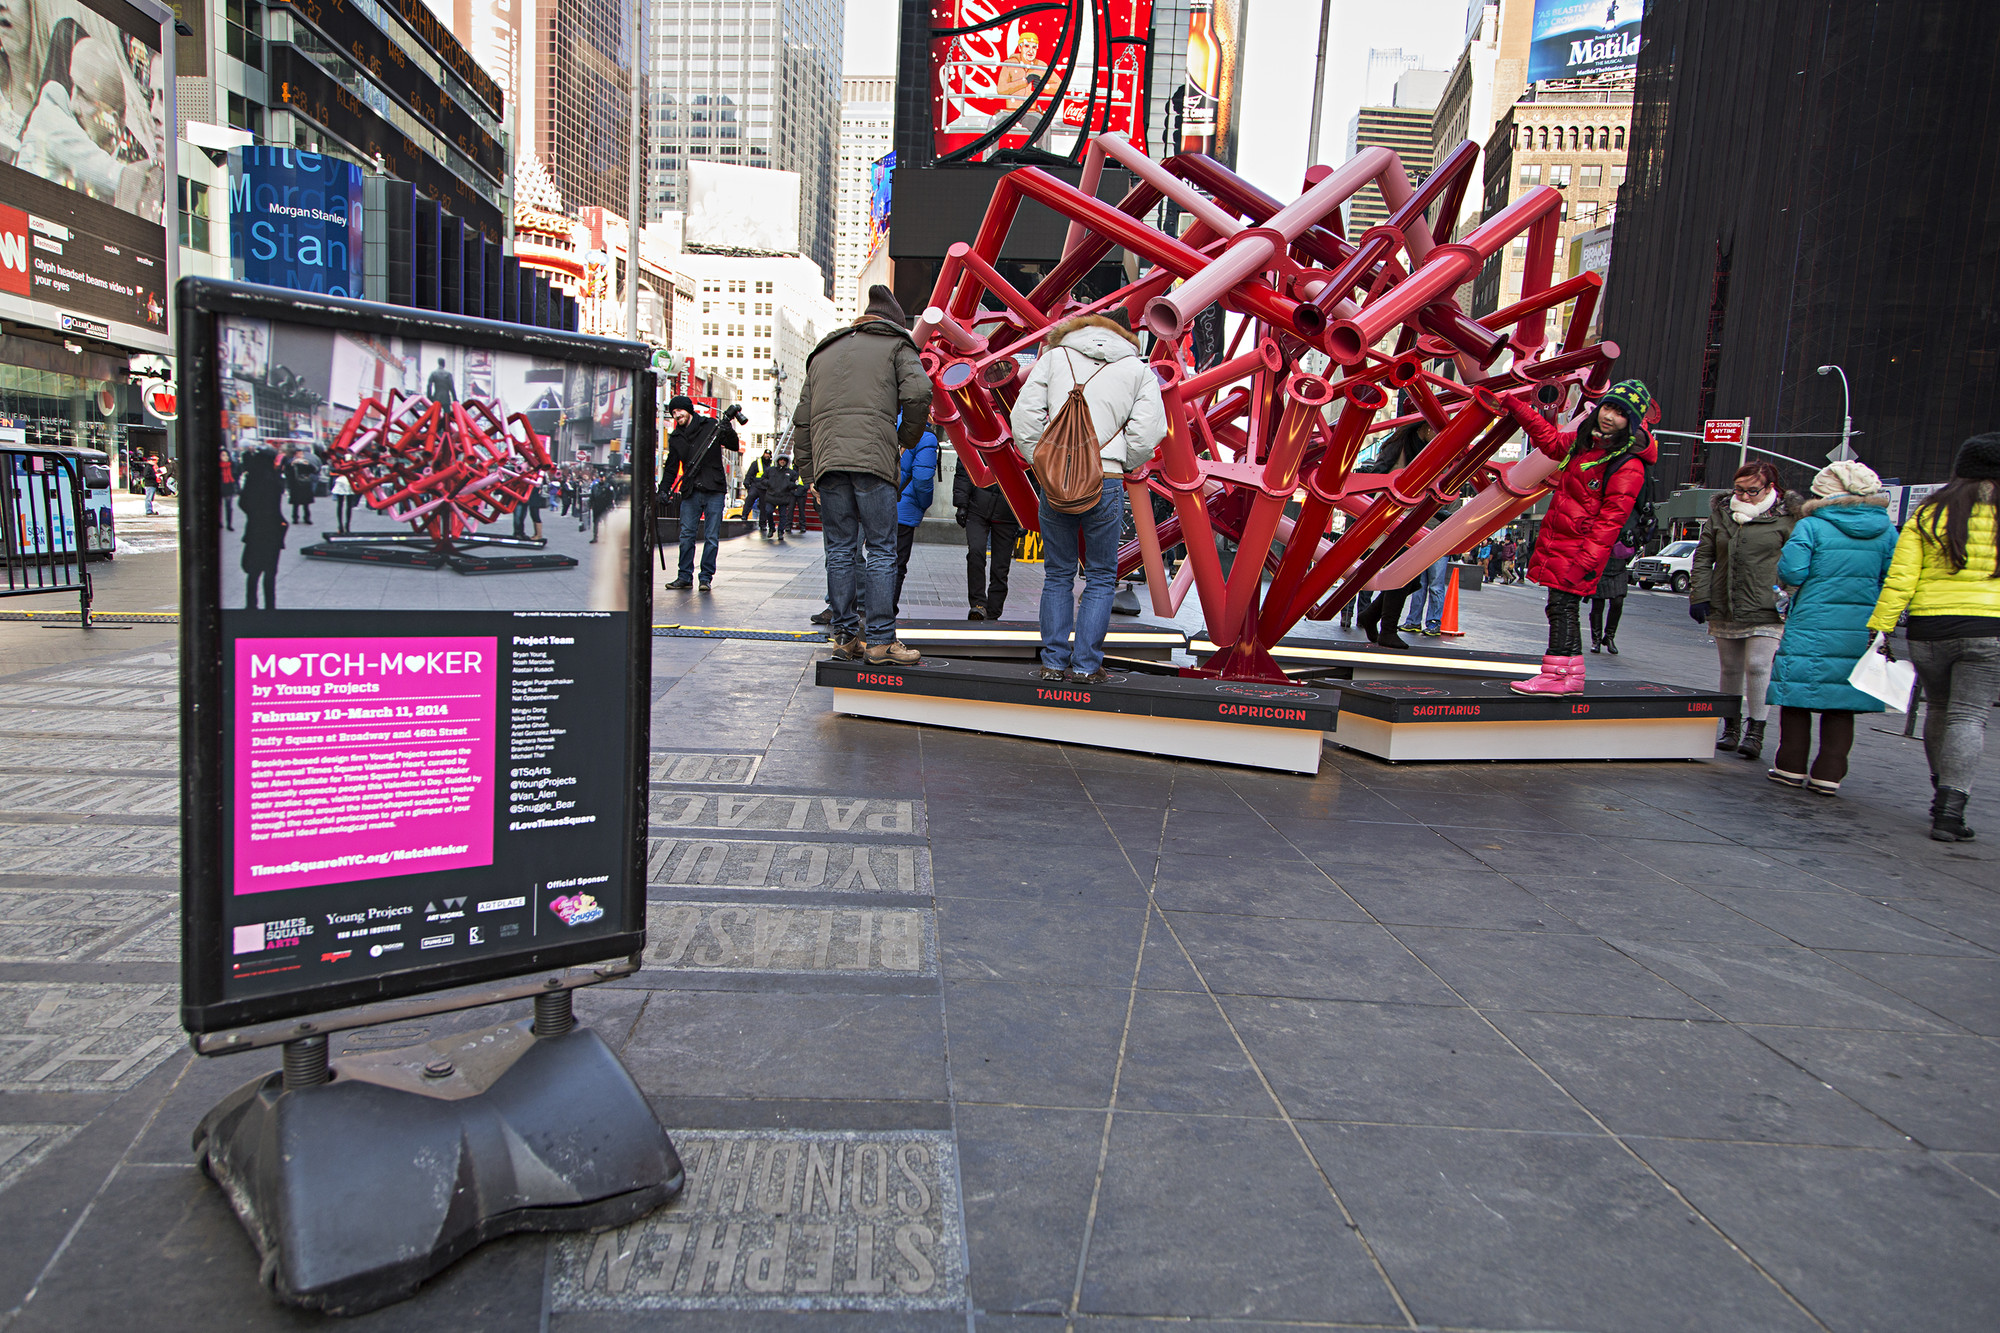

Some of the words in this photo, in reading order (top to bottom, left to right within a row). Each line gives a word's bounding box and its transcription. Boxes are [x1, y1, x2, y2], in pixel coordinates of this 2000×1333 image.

[1566, 32, 1641, 66] Matild
[269, 203, 310, 218] Morgan
[311, 208, 347, 227] Stanley
[104, 245, 120, 255] mobile
[34, 257, 56, 274] Glyph
[57, 264, 85, 282] headset
[85, 275, 108, 289] beams
[109, 281, 126, 294] video
[126, 286, 133, 296] to
[35, 274, 52, 285] your
[52, 278, 70, 292] eyes
[42, 416, 58, 425] BLUE
[513, 636, 548, 646] Project
[549, 636, 574, 644] Team
[856, 672, 904, 687] PISCES
[252, 685, 272, 697] by
[275, 683, 321, 696] Young
[324, 682, 380, 695] Projects
[1036, 688, 1091, 703] TAURUS
[252, 711, 321, 724] February
[395, 706, 413, 718] 11,
[416, 705, 448, 717] 2014
[1218, 703, 1306, 721] CAPRICORN
[1412, 705, 1481, 717] SAGITTARIUS
[1571, 704, 1590, 714] LEO
[1687, 702, 1713, 713] LIBRA
[252, 737, 283, 747] Duffy
[286, 734, 324, 746] Square
[326, 733, 337, 742] at
[339, 730, 391, 742] Broadway
[393, 730, 411, 739] and
[414, 728, 437, 738] 46th
[439, 727, 467, 737] Street
[510, 766, 552, 777] @TSqArts
[510, 777, 576, 789] @YoungProjects
[510, 790, 557, 801] @Van_Alen
[510, 800, 576, 814] @Snuggle_Bear
[649, 794, 913, 832] PALAC
[510, 815, 596, 831] #LoveTimesSquare
[251, 843, 469, 877] TimesSquareNYC.org/MatchMaker
[649, 839, 914, 891] LYCEU
[547, 879, 576, 890] Official
[577, 875, 609, 886] Sponsor
[479, 898, 524, 910] ARTPLACE
[326, 913, 366, 925] Young
[368, 906, 413, 920] Projects
[570, 909, 603, 924] Snuggle
[266, 917, 306, 931] TIMES
[266, 925, 314, 940] SQUARE
[641, 906, 920, 971] BELASC
[266, 937, 300, 950] ARTS
